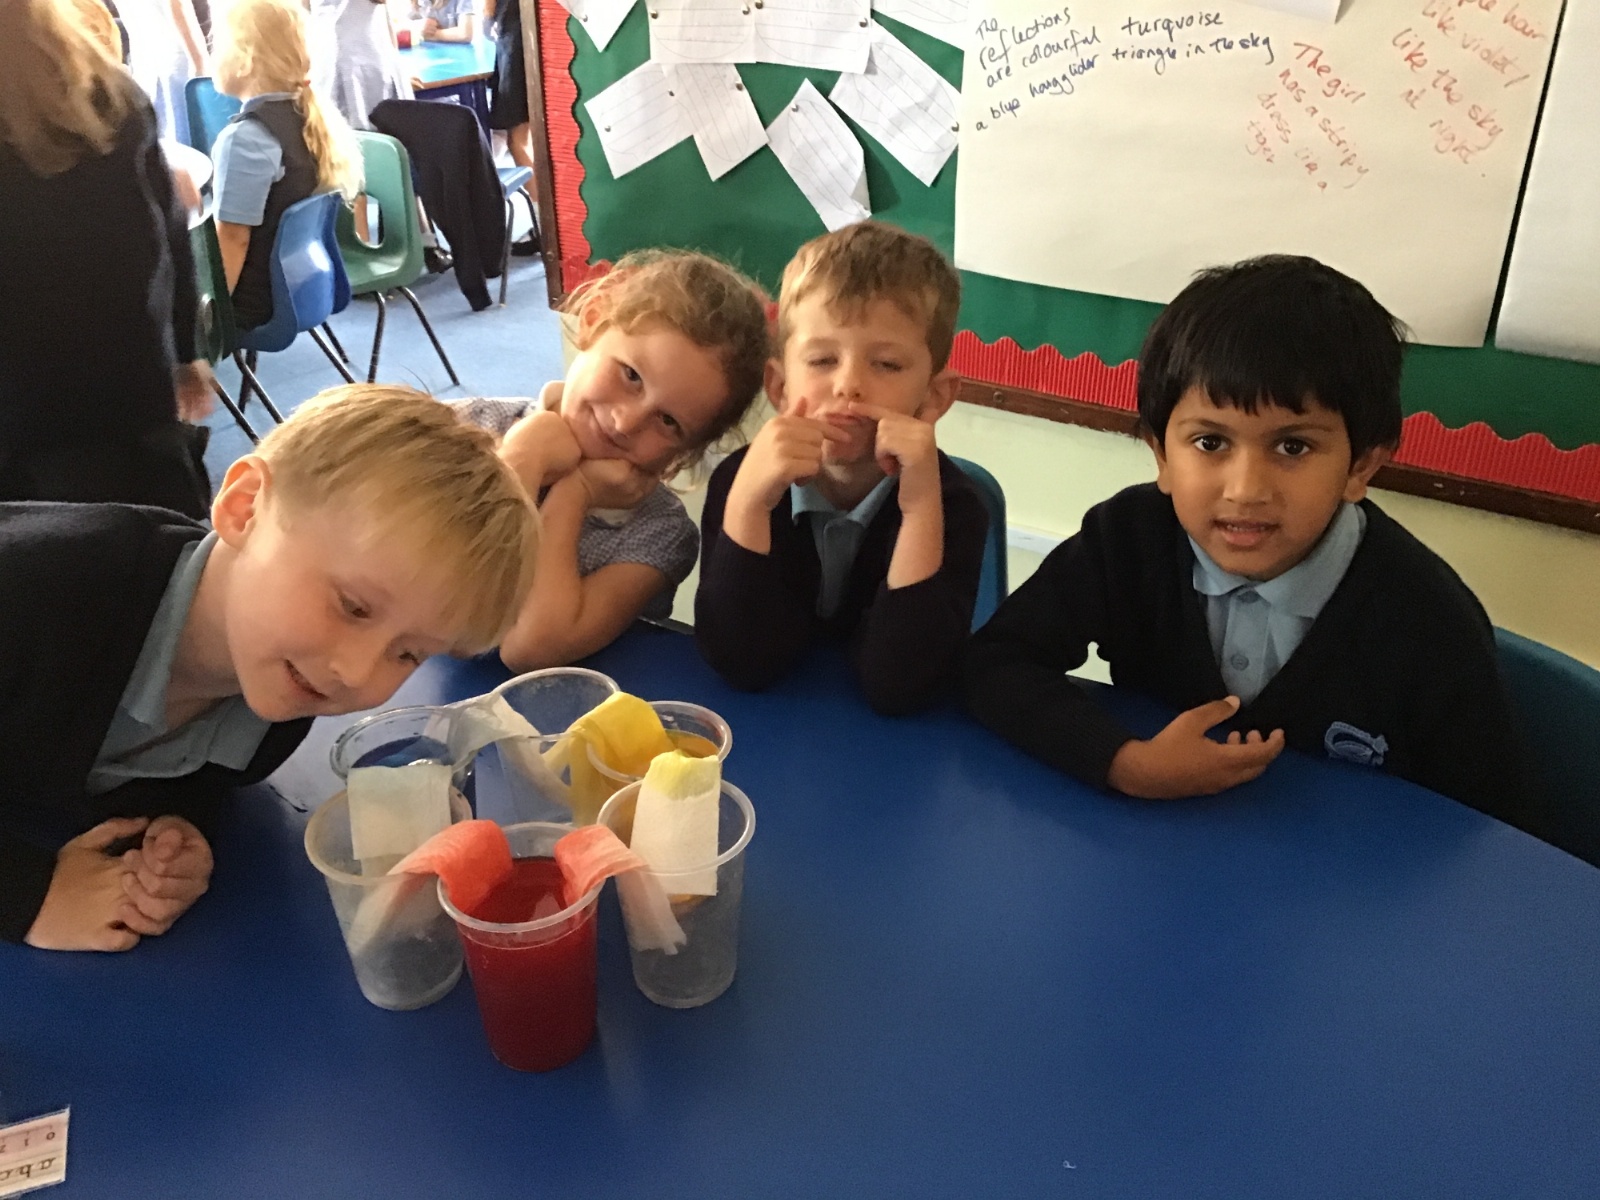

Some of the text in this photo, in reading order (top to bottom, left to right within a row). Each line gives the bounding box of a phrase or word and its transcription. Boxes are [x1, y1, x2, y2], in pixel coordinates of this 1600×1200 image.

[1121, 12, 1224, 42] turquoise
[1186, 43, 1205, 58] in
[1239, 32, 1274, 65] sky
[987, 65, 1012, 88] are
[1279, 68, 1306, 103] has
[1305, 105, 1319, 118] a
[976, 121, 988, 131] a
[1468, 104, 1504, 151] sky
